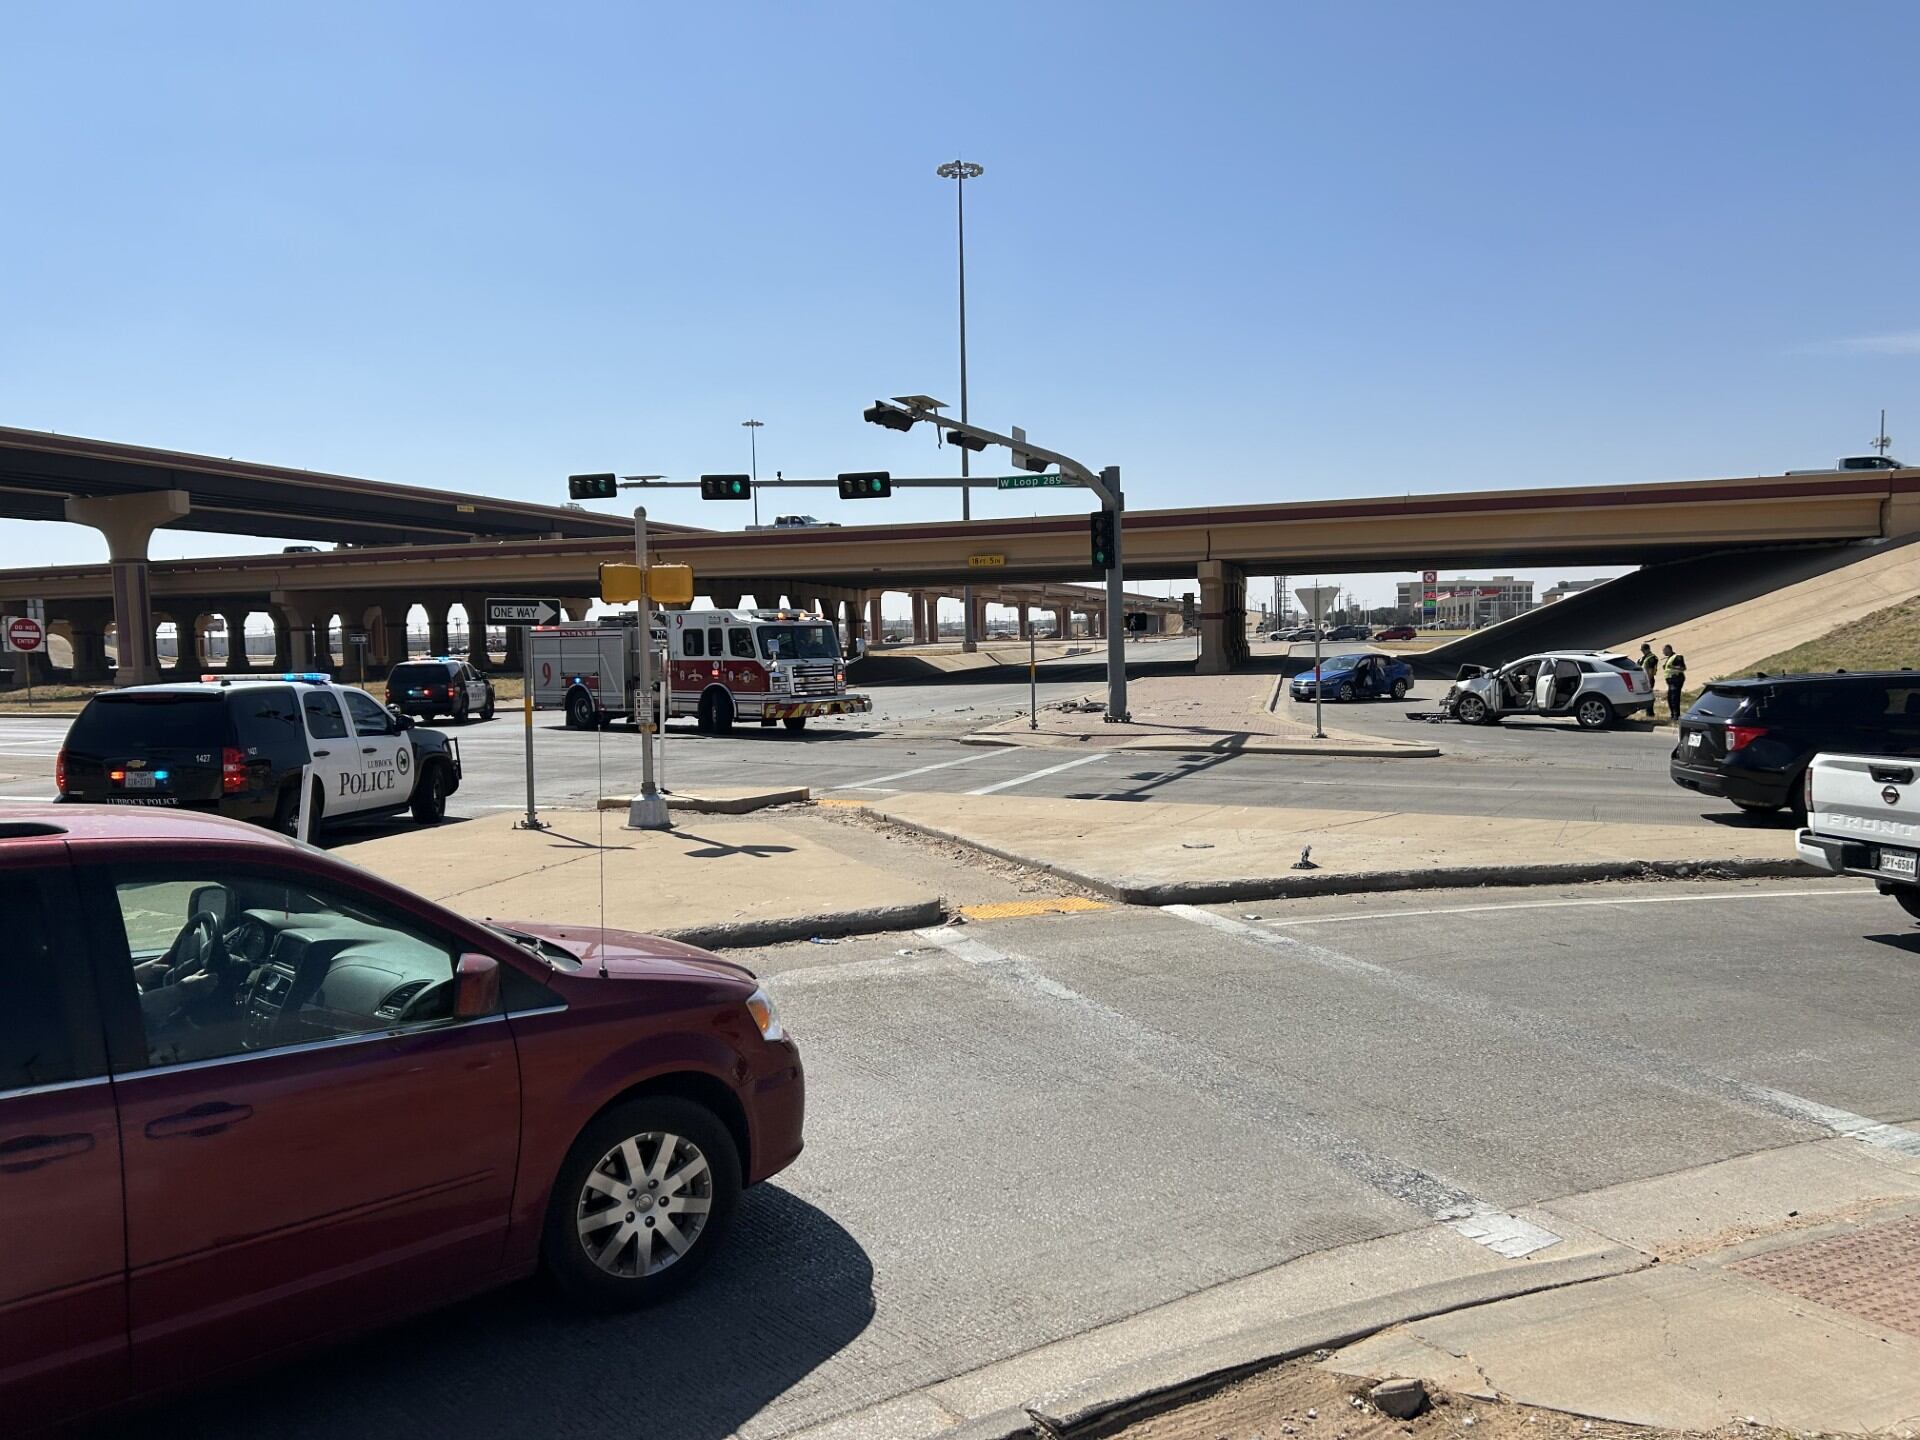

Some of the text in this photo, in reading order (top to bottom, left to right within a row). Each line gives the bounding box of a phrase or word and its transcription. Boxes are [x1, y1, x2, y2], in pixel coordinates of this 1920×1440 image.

[1000, 479, 1009, 487] W
[1014, 478, 1039, 488] Loop
[494, 607, 537, 618] ONE WAY
[676, 614, 683, 629] 9
[542, 662, 551, 687] 9
[196, 754, 211, 763] 1427
[367, 759, 393, 769] LUBBOCK
[338, 769, 395, 796] POLICE
[146, 797, 178, 805] POLICE
